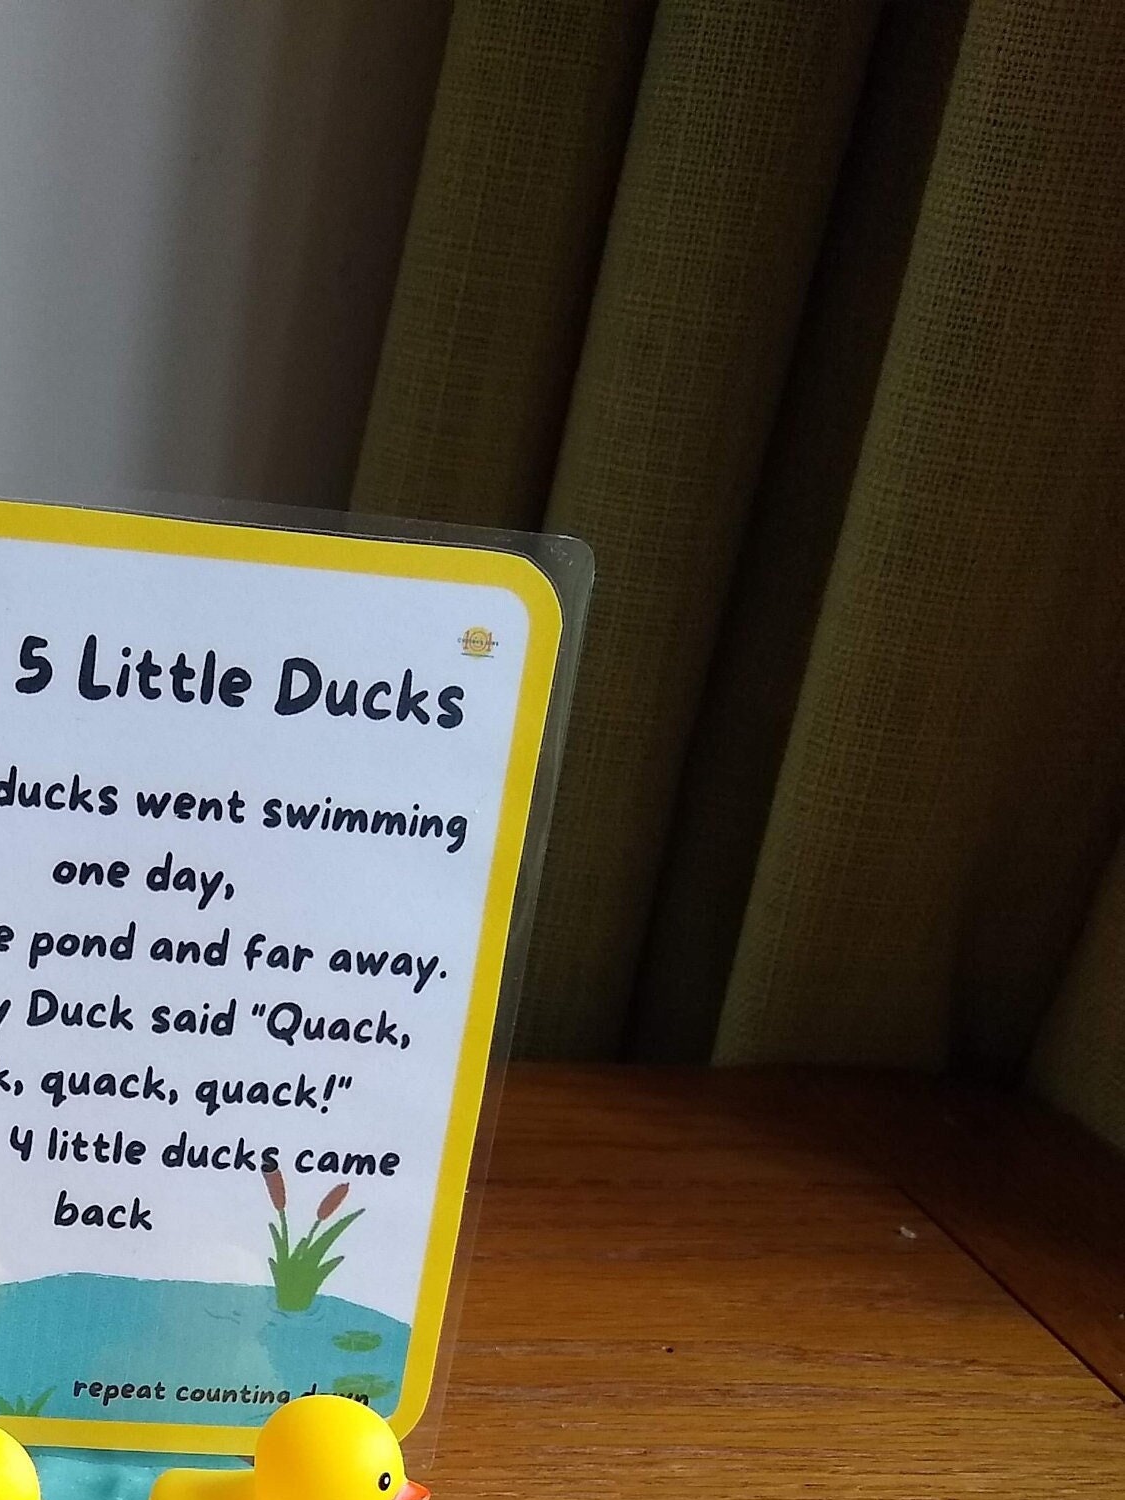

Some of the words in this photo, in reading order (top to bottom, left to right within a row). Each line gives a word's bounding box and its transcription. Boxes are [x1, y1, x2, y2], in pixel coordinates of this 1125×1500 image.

[15, 634, 53, 695] 5
[78, 634, 253, 708] Little
[274, 657, 465, 729] Ducks
[136, 790, 246, 824] went
[262, 796, 468, 854] swimming
[52, 860, 130, 889] one
[146, 851, 235, 911] day,
[28, 920, 137, 970] pond
[149, 927, 230, 967] and
[243, 933, 314, 973] far
[328, 949, 447, 994] away.
[26, 988, 134, 1031] Duck
[151, 998, 237, 1037] said
[251, 1001, 411, 1050] "Quack,
[40, 1065, 179, 1108] quack,
[195, 1073, 353, 1117] quack!"
[9, 1125, 34, 1162] 4
[47, 1126, 147, 1166] little
[161, 1130, 282, 1174] ducks
[294, 1149, 400, 1177] came
[53, 1189, 153, 1231] back
[73, 1380, 166, 1406] repeat
[176, 1383, 291, 1405] counting
